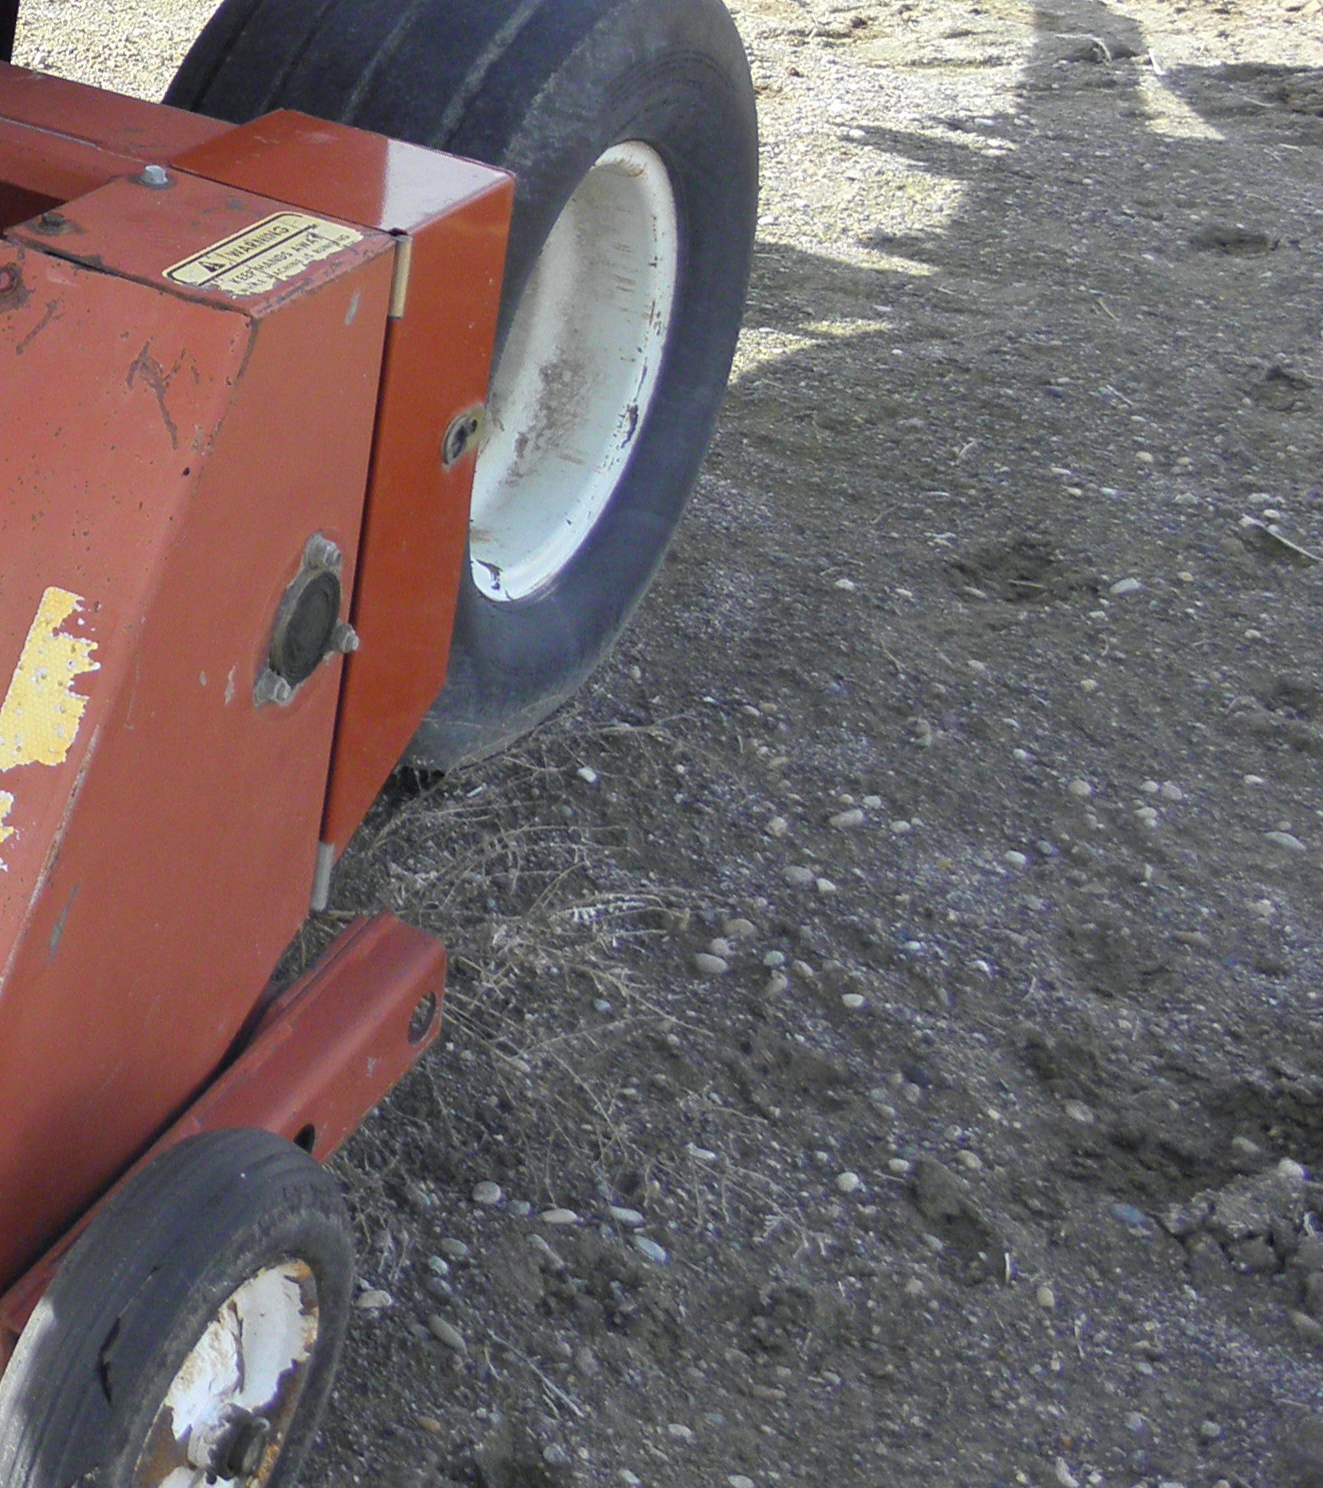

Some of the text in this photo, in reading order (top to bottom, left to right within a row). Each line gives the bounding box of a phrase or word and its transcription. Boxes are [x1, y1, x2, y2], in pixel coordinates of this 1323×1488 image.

[226, 226, 289, 257] WARNING
[232, 269, 254, 284] KEEP
[254, 252, 293, 272] HANDS
